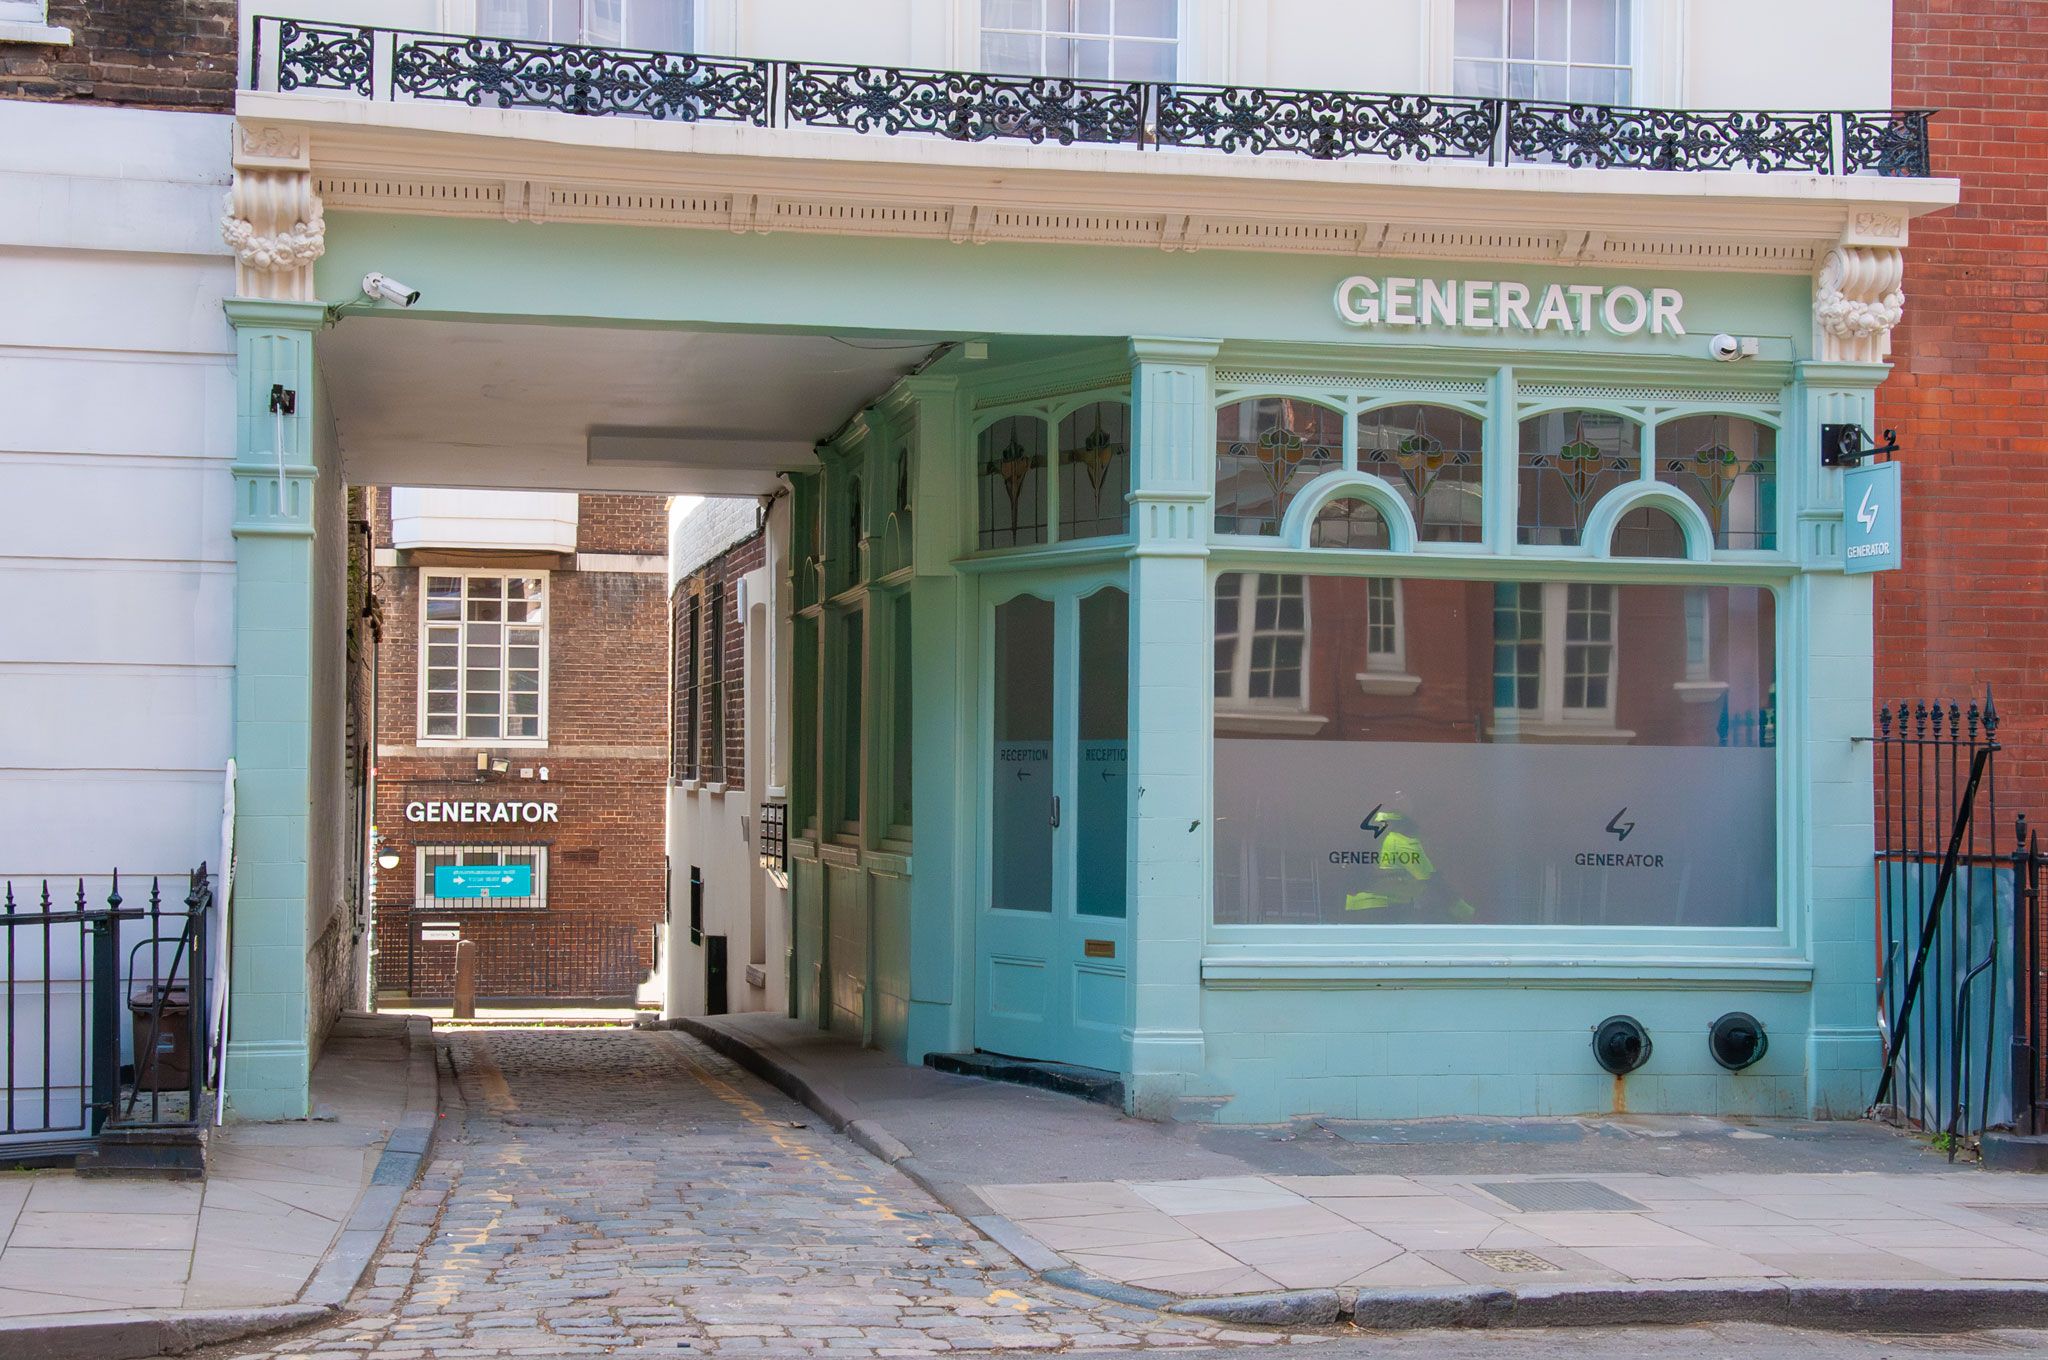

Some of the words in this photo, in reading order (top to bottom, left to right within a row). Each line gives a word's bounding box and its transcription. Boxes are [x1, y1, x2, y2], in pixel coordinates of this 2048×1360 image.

[1334, 276, 1686, 335] GENERATOR
[1847, 542, 1890, 558] GENERATOR
[1001, 749, 1048, 761] RECEPTION
[1086, 748, 1128, 761] RECEPTIO
[406, 802, 558, 823] GENERATOR
[1329, 851, 1420, 864] GENERATOR
[1575, 853, 1664, 867] GENERATOR
